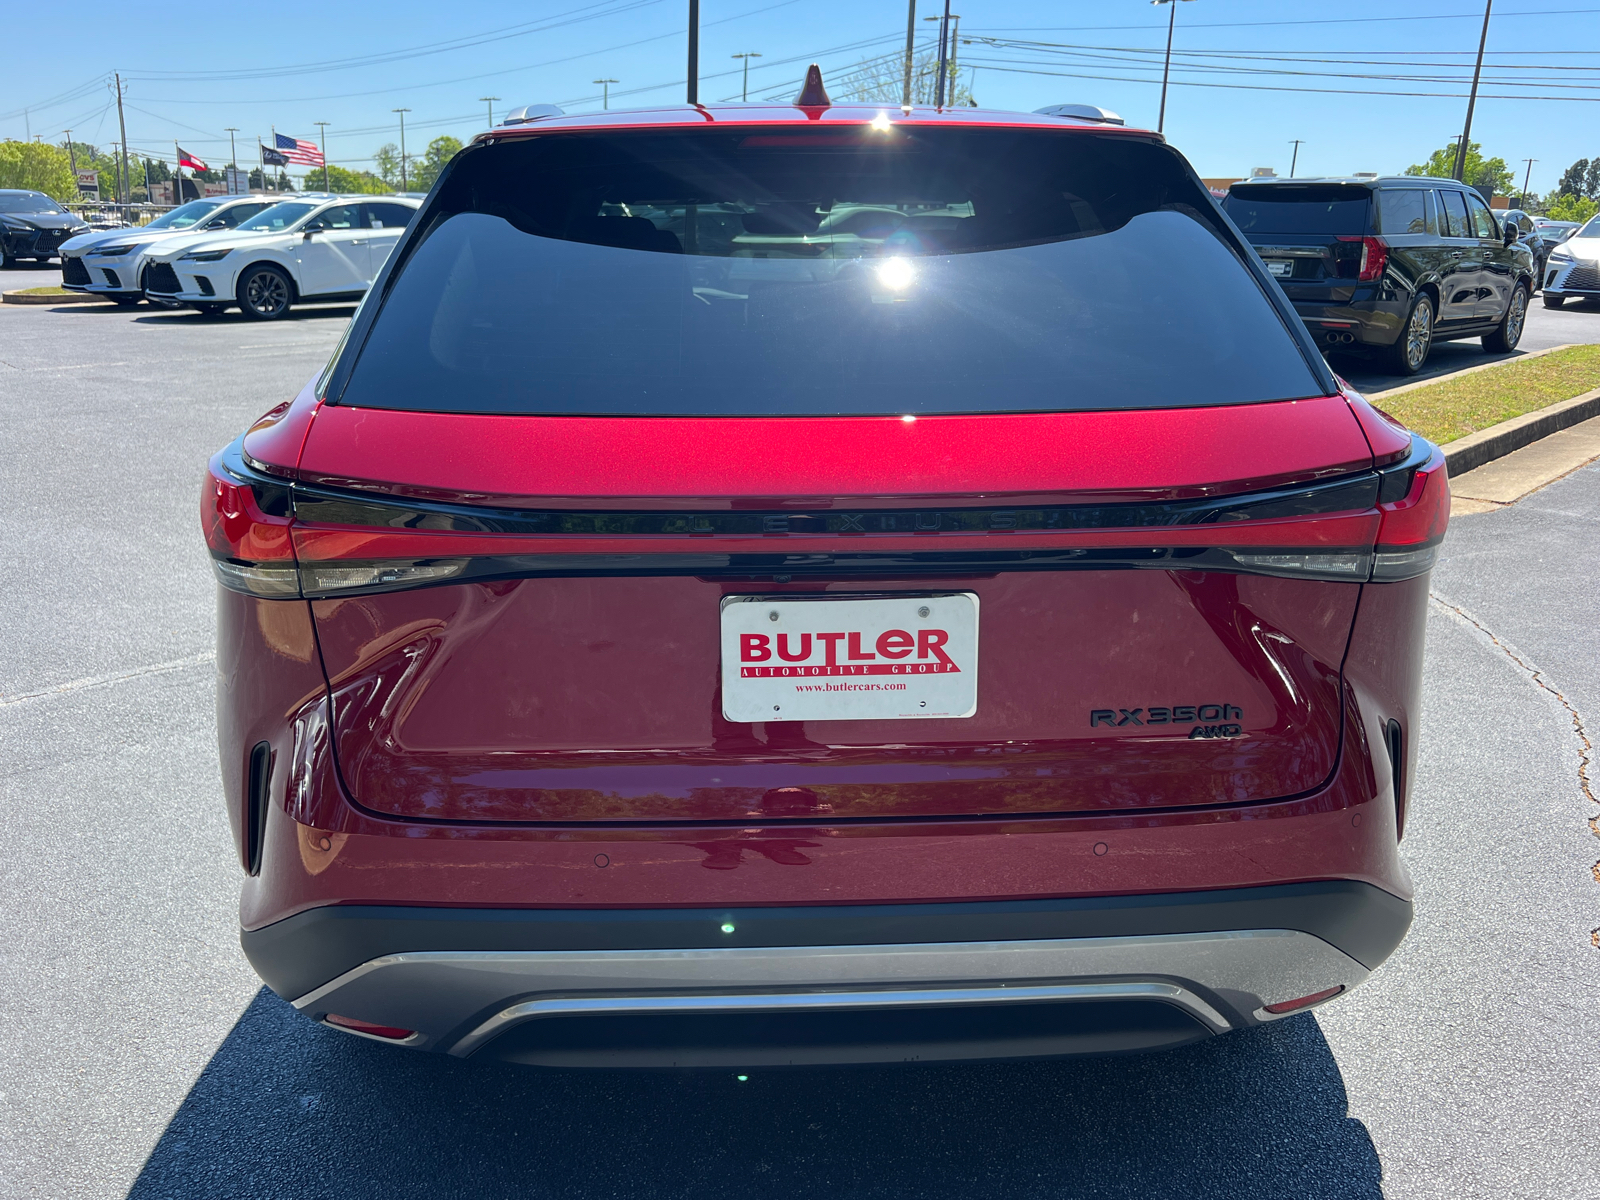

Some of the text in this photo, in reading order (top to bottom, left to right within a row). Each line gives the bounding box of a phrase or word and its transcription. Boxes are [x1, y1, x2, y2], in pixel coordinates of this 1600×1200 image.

[688, 511, 1017, 533] LEXUS
[741, 664, 954, 677] AUTOMOTIVE GROUP
[795, 681, 907, 693] www.butlercars.com
[1187, 723, 1243, 740] AWD
